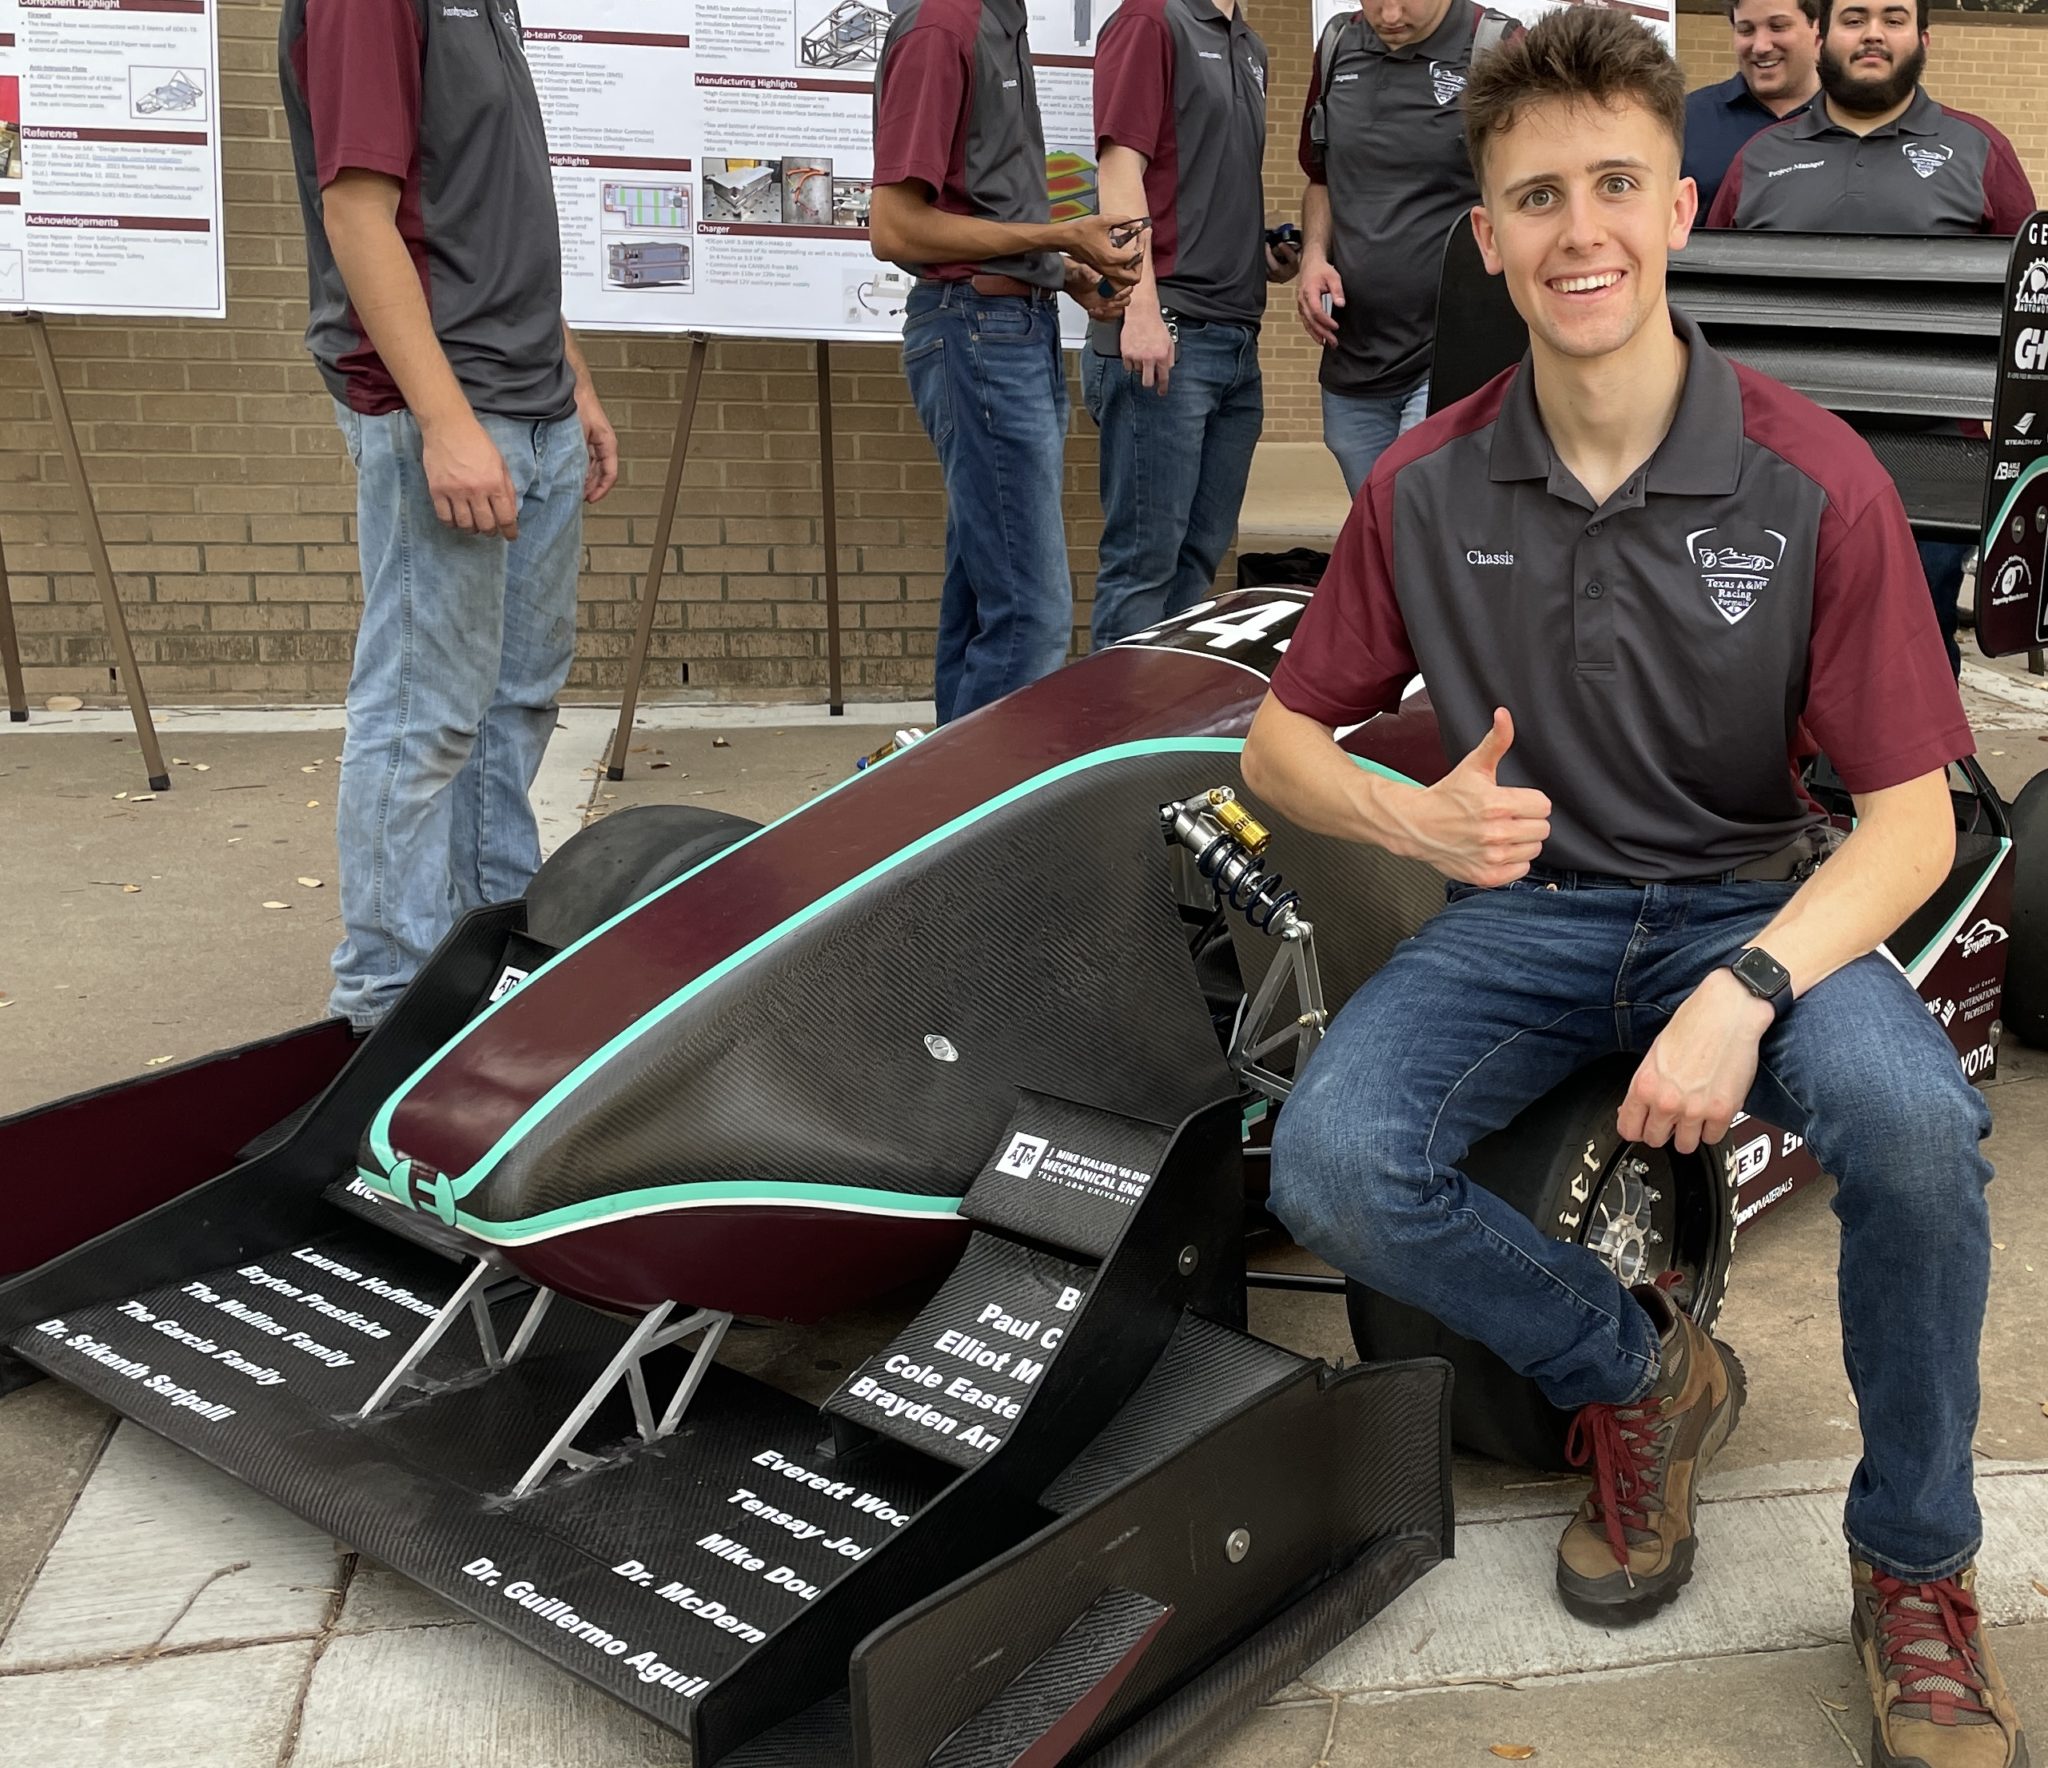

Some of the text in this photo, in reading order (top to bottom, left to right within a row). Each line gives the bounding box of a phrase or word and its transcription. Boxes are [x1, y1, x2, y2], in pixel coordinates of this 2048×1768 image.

[558, 31, 583, 41] Scope
[696, 75, 798, 89] Manufacturing Highlights
[22, 128, 78, 139] References
[549, 157, 590, 166] Highlights
[26, 215, 119, 228] Acknowledgements
[698, 224, 730, 235] Charger
[1466, 550, 1515, 566] Chassis
[1706, 578, 1736, 589] Texas
[1718, 588, 1752, 602] Racing
[1040, 1158, 1145, 1197] MECHANICAL ENG
[1056, 1149, 1081, 1163] MIKE
[1079, 1156, 1118, 1175] WALKER
[1037, 1170, 1064, 1184] TEXAS
[1087, 1186, 1136, 1206] UNIVERSIT
[236, 1265, 391, 1340] Bryton Praslicka
[291, 1247, 441, 1320] Lauren Hoffman
[1055, 1286, 1086, 1313] B
[117, 1300, 287, 1386] The Garcia Family
[181, 1281, 356, 1368] The Mullins Family
[976, 1302, 1064, 1350] Paul C
[36, 1318, 237, 1422] Dr. Srikanth Saripalli
[933, 1329, 1044, 1385] Elliot M
[848, 1375, 959, 1435] Brayden
[884, 1353, 1022, 1420] Cole Easte
[752, 1450, 856, 1501] Everett
[727, 1488, 825, 1540] Tensay
[695, 1533, 766, 1572] Mike
[611, 1559, 654, 1587] Dr.
[461, 1557, 502, 1587] Dr.
[503, 1581, 628, 1656] Guillermo
